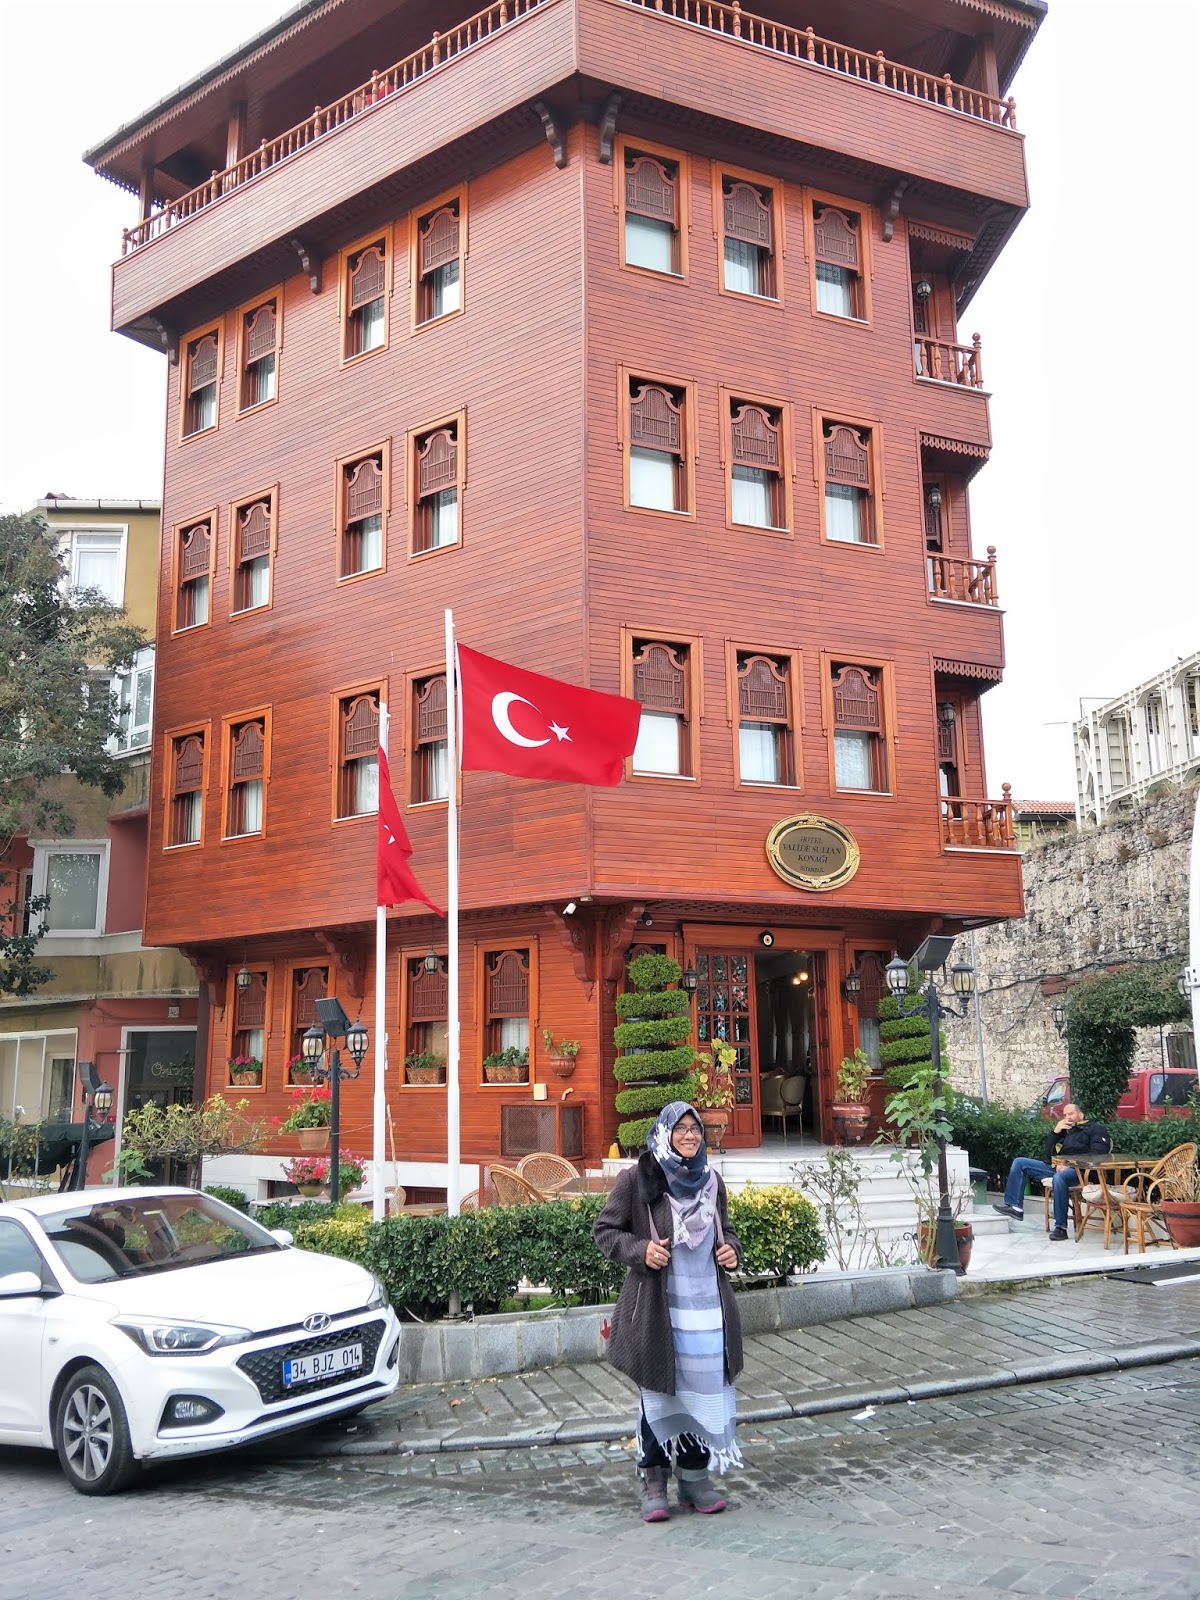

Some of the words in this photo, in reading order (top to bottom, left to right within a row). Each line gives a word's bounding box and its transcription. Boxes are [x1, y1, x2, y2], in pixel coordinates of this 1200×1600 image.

[800, 836, 823, 844] HOTEL
[812, 846, 841, 854] SULTAN
[798, 854, 828, 863] KONAĞI
[292, 1361, 306, 1380] 34
[313, 1354, 333, 1373] BJZ
[342, 1347, 359, 1366] 014
